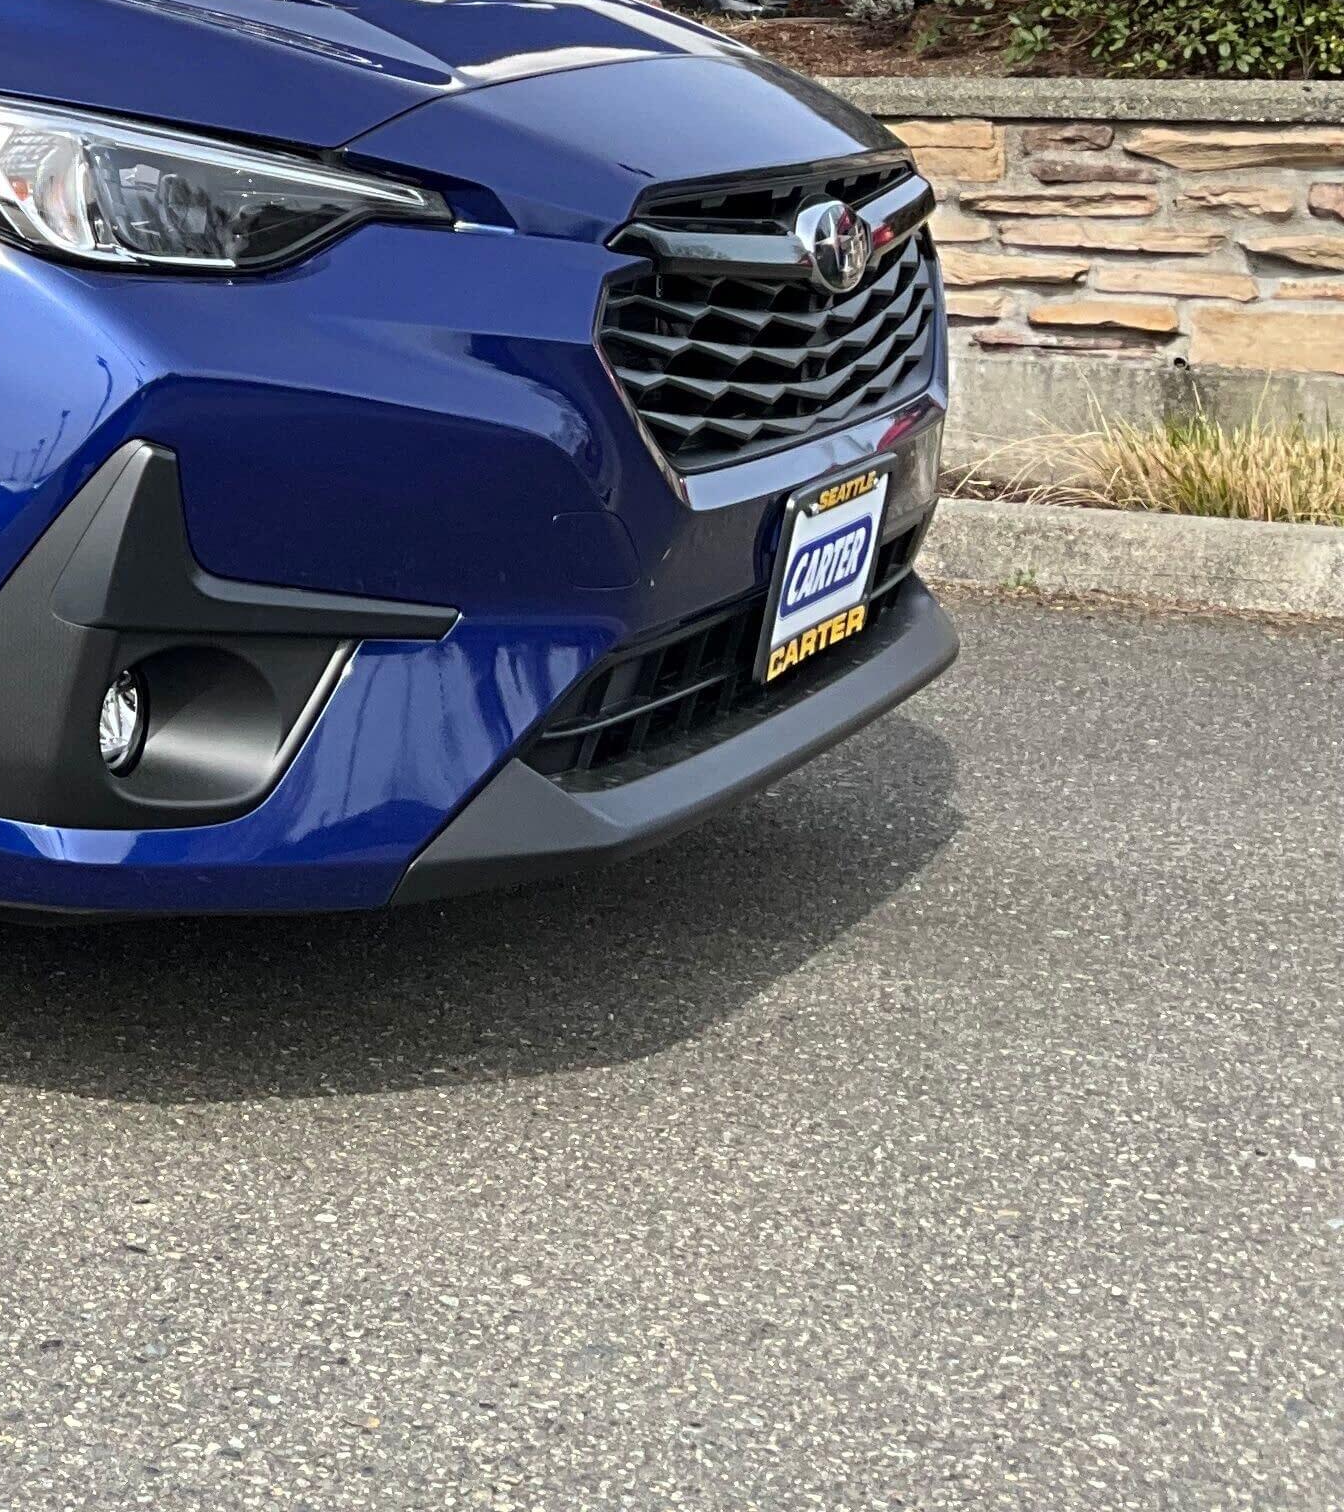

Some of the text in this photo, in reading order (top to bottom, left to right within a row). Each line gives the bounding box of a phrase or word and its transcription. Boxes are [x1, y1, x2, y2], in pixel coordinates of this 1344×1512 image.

[817, 471, 877, 510] SEATTLE
[787, 526, 866, 607] CARTER
[766, 605, 866, 682] CARTER
